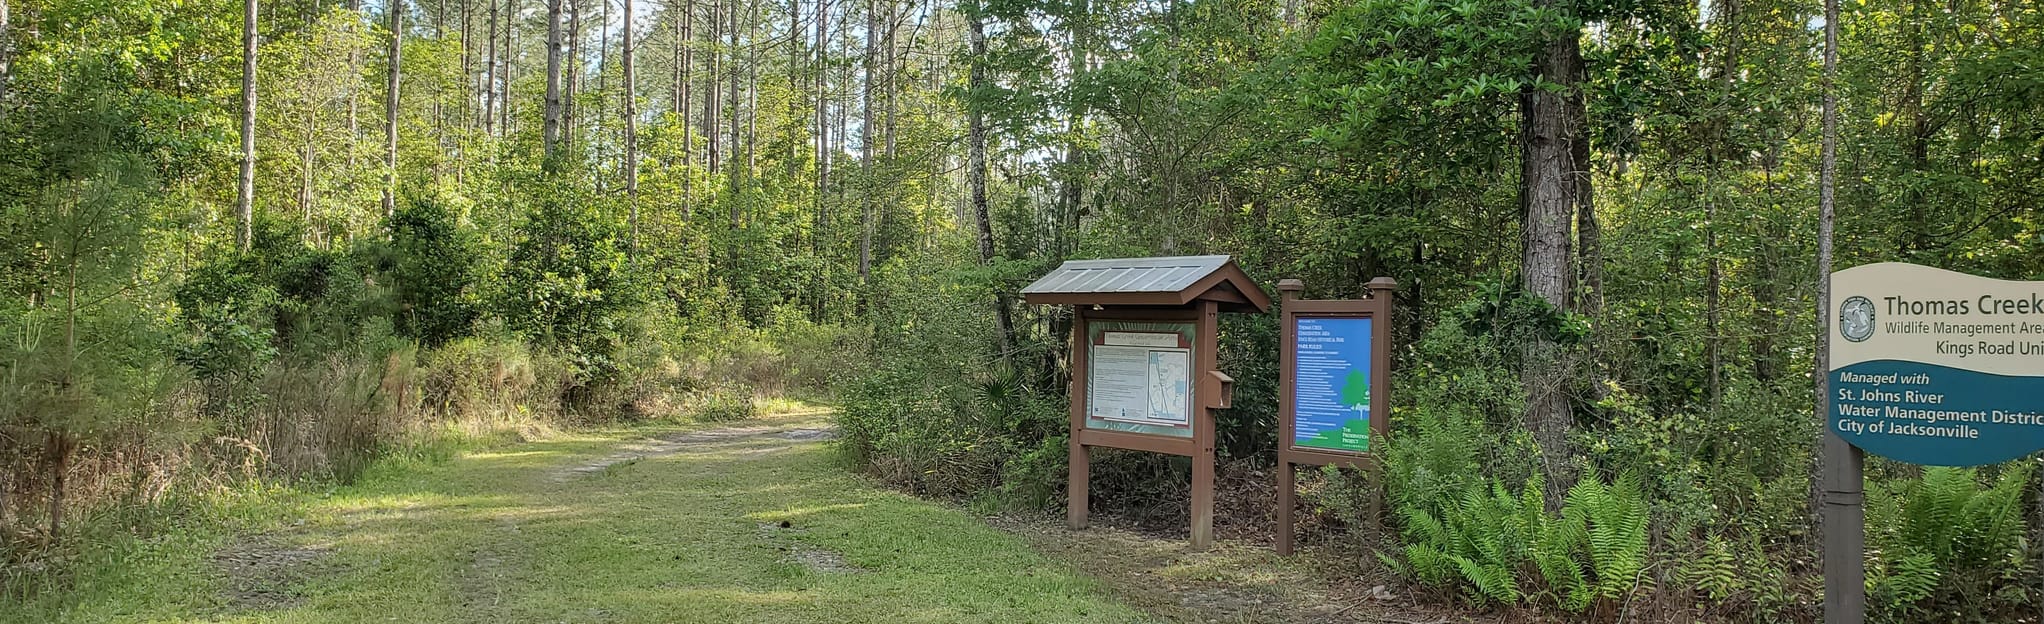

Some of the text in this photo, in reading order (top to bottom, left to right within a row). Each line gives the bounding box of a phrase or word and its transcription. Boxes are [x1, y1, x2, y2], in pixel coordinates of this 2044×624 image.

[1884, 293, 2044, 316] Thomas Creek
[1885, 321, 2044, 337] Wildlife Management Are
[1936, 341, 2044, 358] Kings Road Uni
[1839, 372, 1930, 387] Managed with
[1838, 388, 1944, 404] St. Johns River
[1838, 404, 2044, 426] Water Management Distric
[1838, 418, 1979, 439] City of Jacksonville
